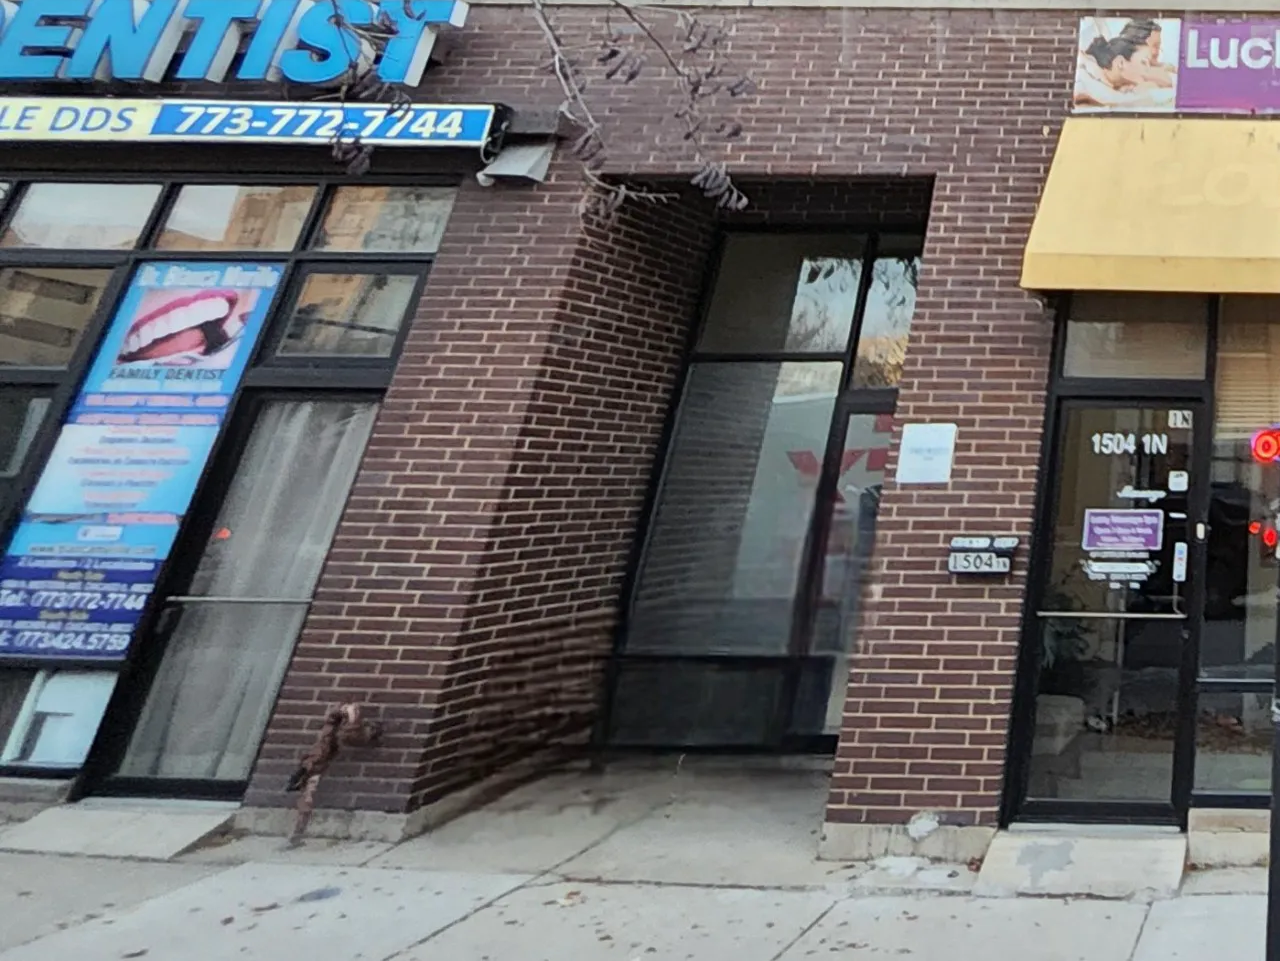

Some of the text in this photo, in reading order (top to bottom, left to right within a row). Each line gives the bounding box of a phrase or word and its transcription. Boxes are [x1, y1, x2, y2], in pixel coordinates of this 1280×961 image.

[48, 106, 138, 132] DDS
[175, 105, 464, 140] 773-772-7744
[109, 368, 227, 381] FAMILY DENTIST
[1092, 433, 1169, 455] 1504 1N
[952, 554, 993, 569] 1504
